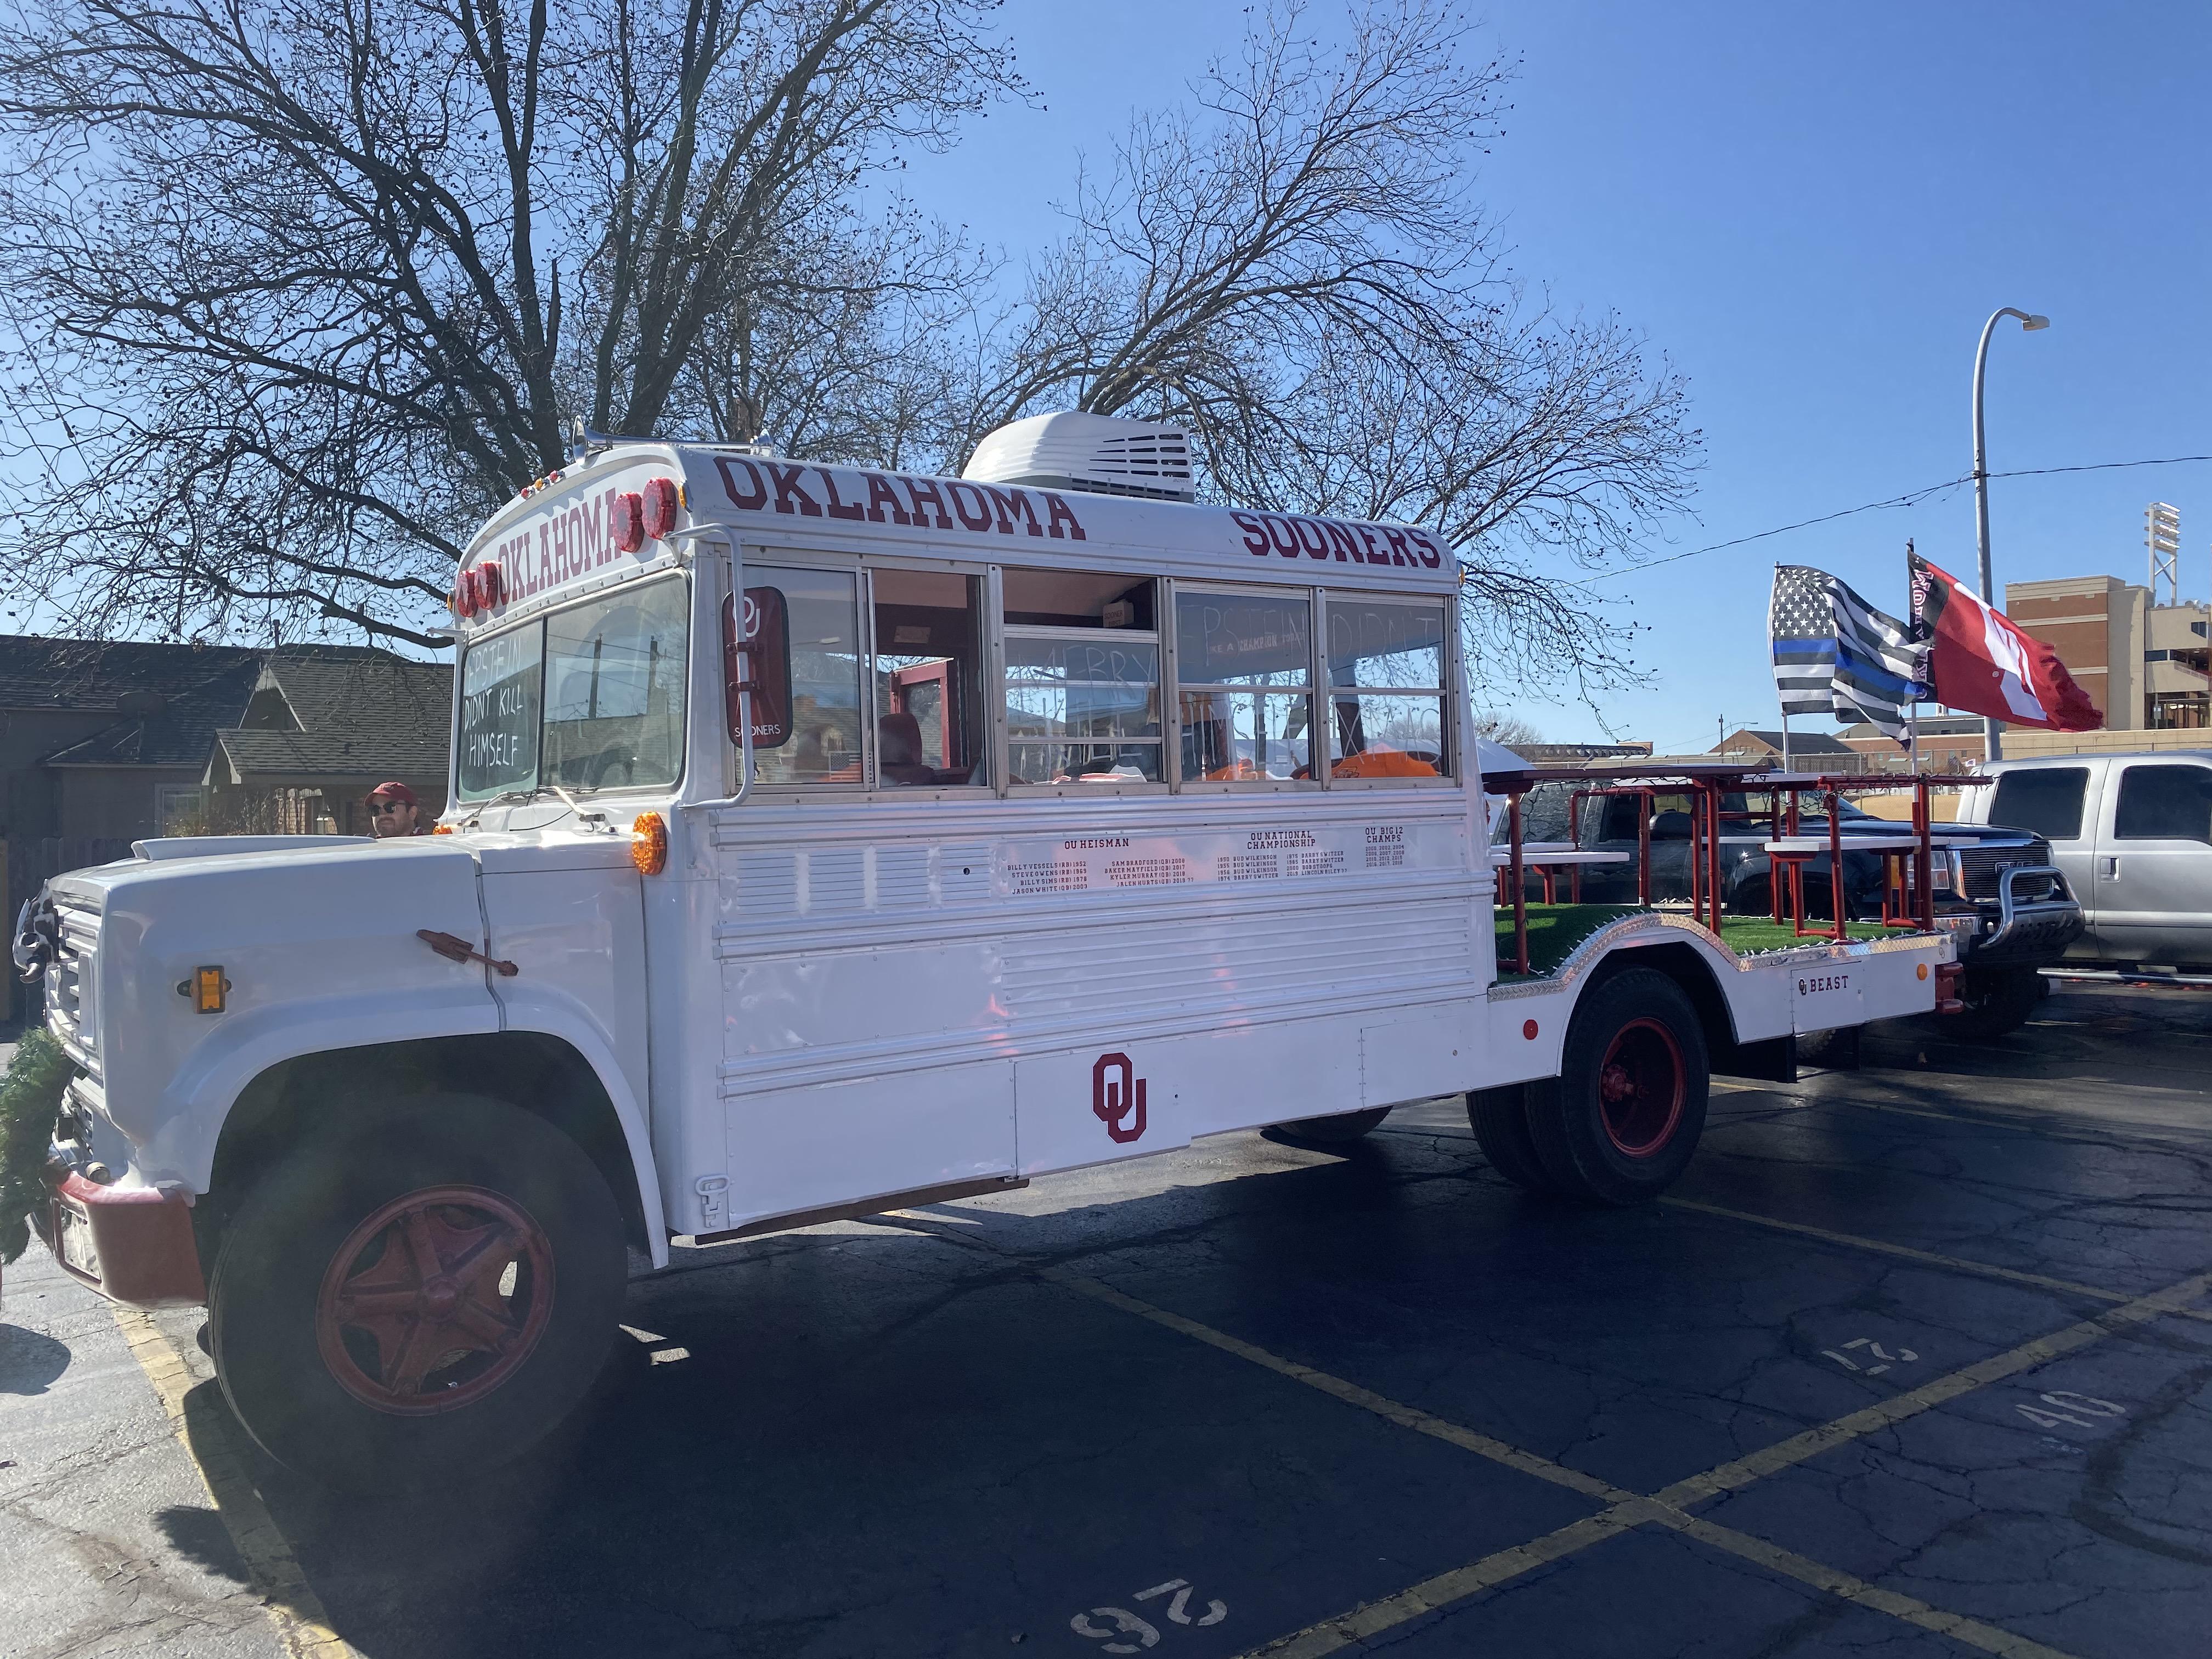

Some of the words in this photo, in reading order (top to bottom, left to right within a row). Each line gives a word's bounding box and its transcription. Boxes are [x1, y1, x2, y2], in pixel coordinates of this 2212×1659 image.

[713, 455, 1087, 541] OKLAHOMA
[1229, 511, 1441, 568] SOONERS
[468, 636, 521, 694] EPSTEIN
[499, 684, 523, 717] KILL
[469, 732, 518, 768] HIMSELF
[1064, 840, 1077, 850] OU
[1080, 838, 1130, 849] HEISMAN
[1247, 839, 1316, 849] CHAMPIONSHIP
[1251, 832, 1262, 841] OU
[1265, 830, 1312, 840] NATIONAL
[1365, 827, 1376, 835] OU
[1380, 826, 1393, 834] BIG
[1367, 834, 1401, 843] CHAMPS
[1810, 975, 1849, 992] BEAST
[1093, 1052, 1147, 1144] OU
[1070, 1578, 1228, 1654] 26
